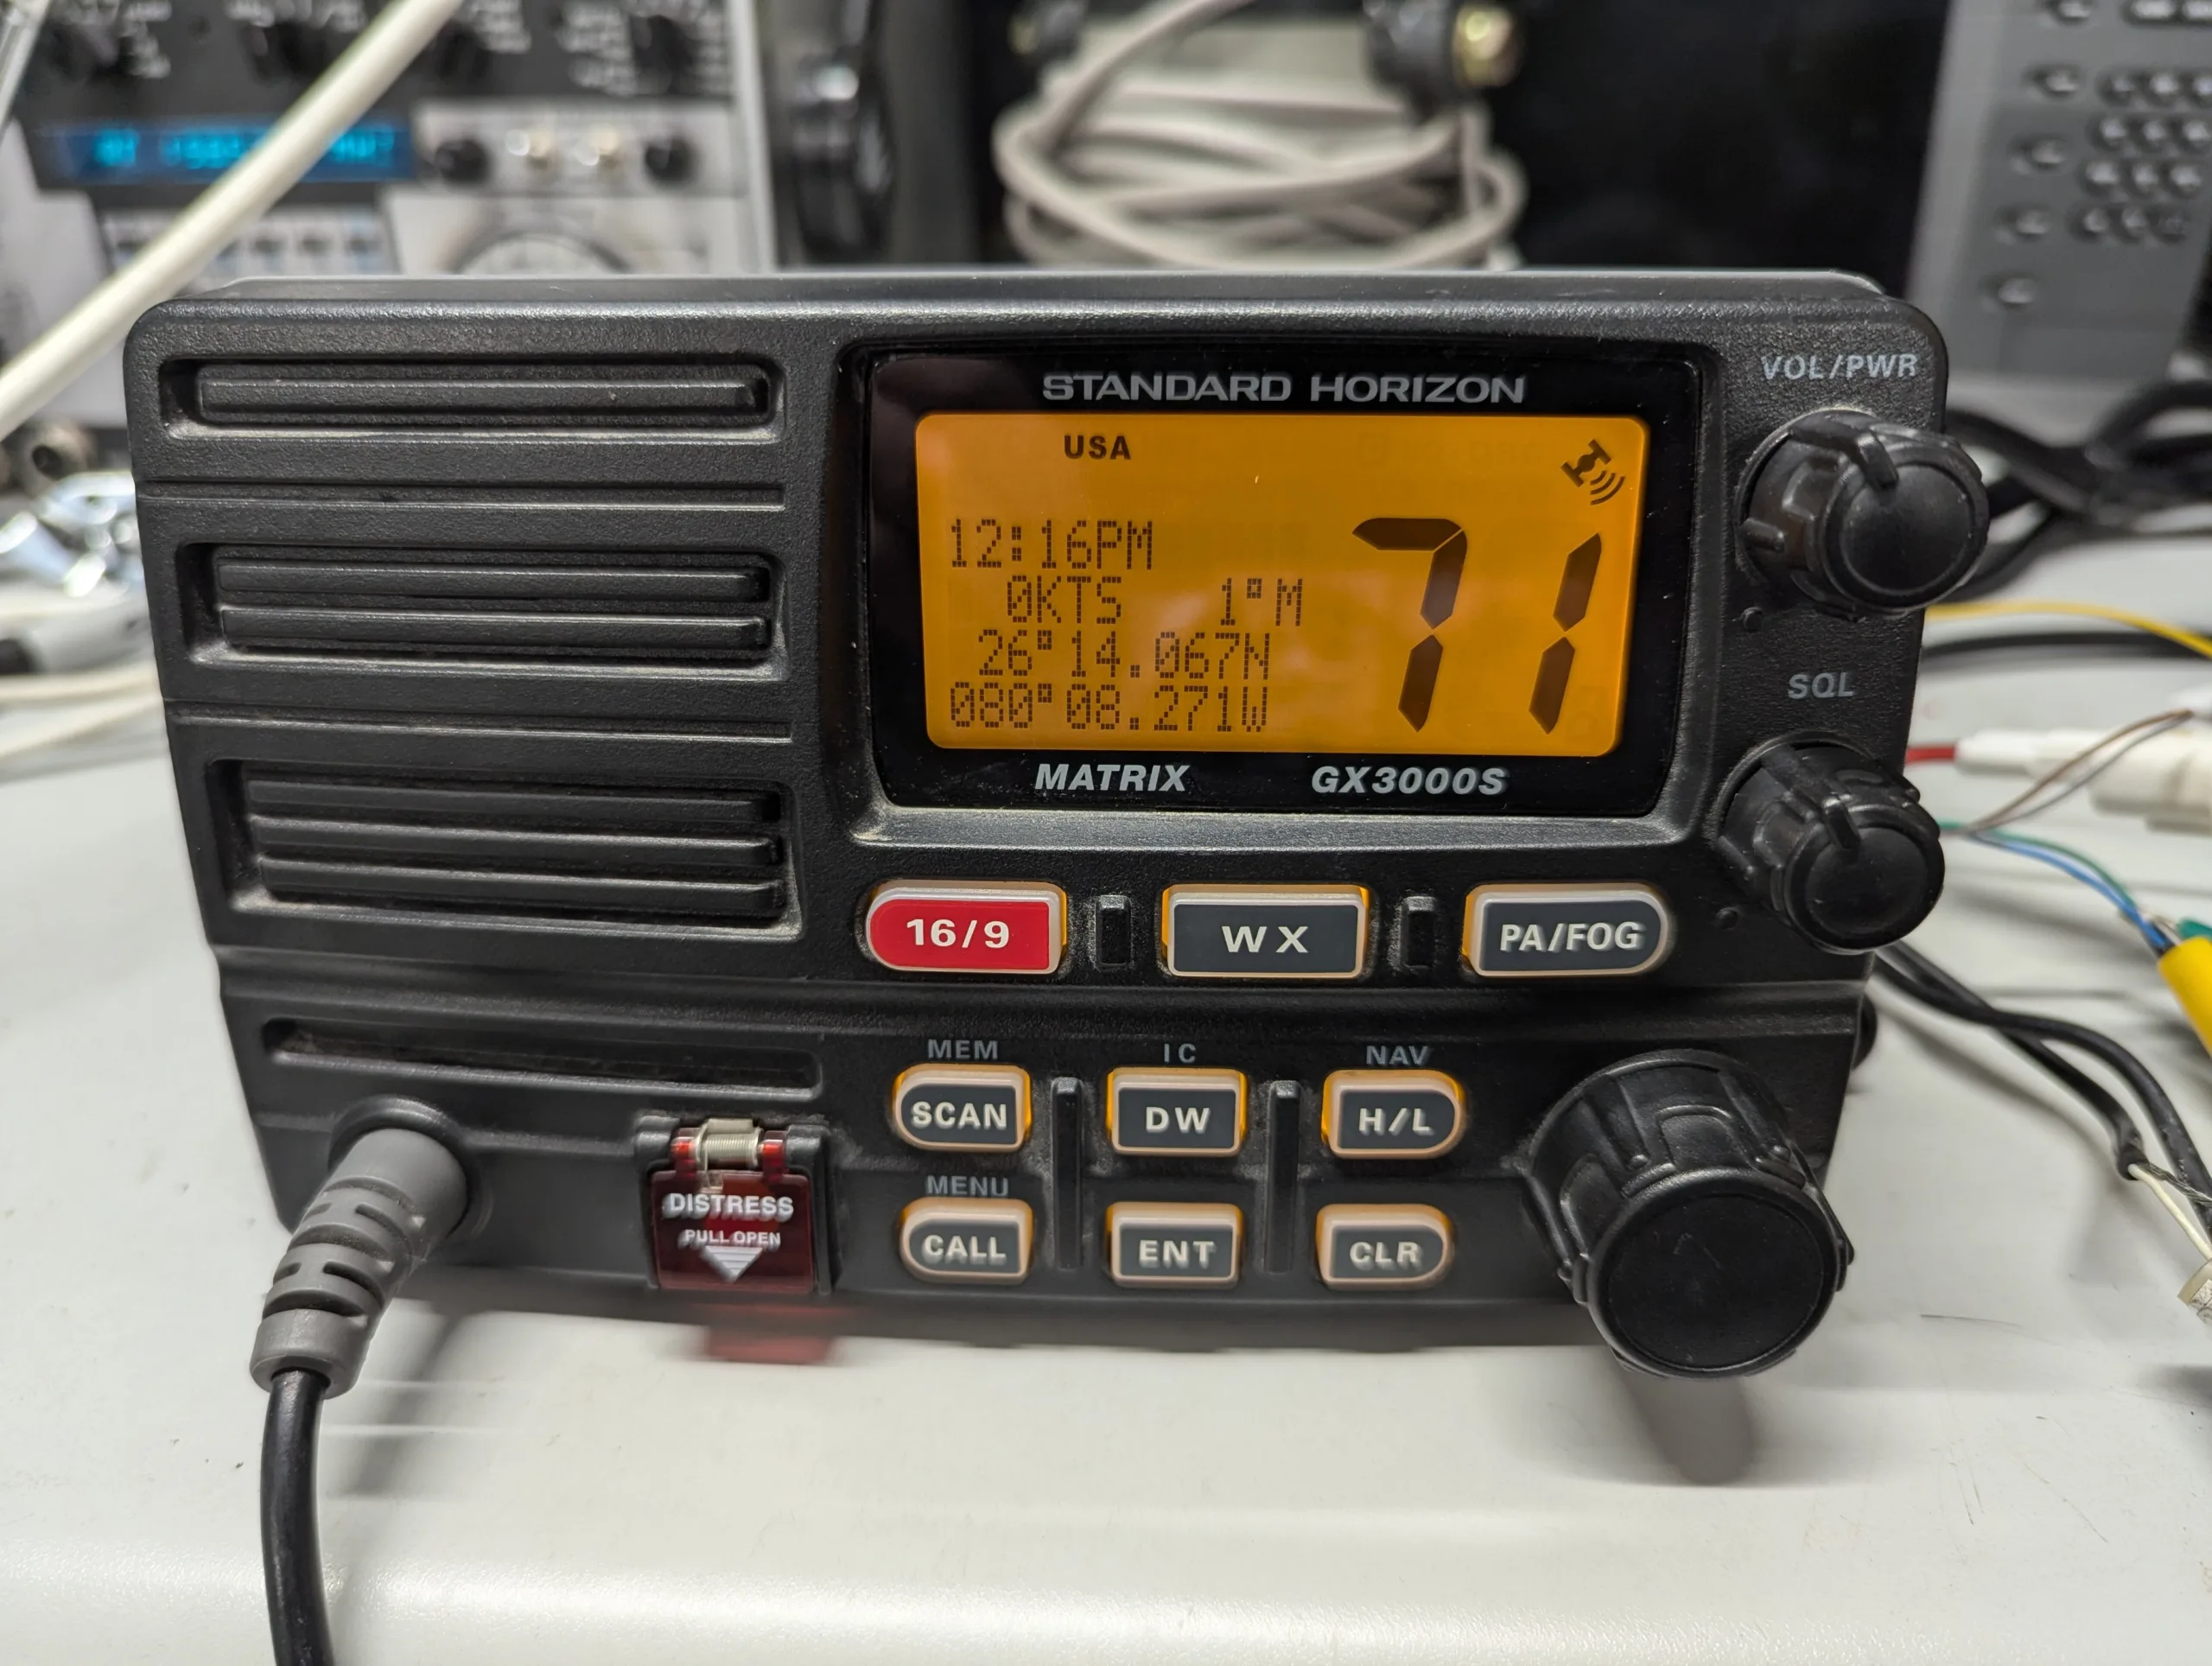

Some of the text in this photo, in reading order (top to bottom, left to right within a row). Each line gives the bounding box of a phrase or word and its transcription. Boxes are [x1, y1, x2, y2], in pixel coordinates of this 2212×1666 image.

[1762, 353, 1918, 383] VOL/PWR
[1042, 373, 1526, 405] STANDARD HORIZON
[1063, 434, 1132, 461] USA
[950, 518, 1153, 570] 12:16PM
[1007, 575, 1122, 624] 0KTS
[1351, 516, 1603, 734] 71
[1787, 671, 1855, 701] SQL
[1036, 763, 1509, 797] MATRIX GX3000S
[906, 918, 1011, 951] 16/9
[1498, 920, 1640, 952] PA/FOG
[927, 1040, 999, 1060] MEM
[1163, 1043, 1198, 1064] IC
[1364, 1045, 1429, 1066] NAV
[911, 1101, 1008, 1130] SCAN
[1145, 1105, 1211, 1133] DW
[1357, 1107, 1433, 1136] H/L
[925, 1175, 1009, 1199] MENU
[664, 1192, 794, 1221] DISTRESS
[680, 1229, 781, 1250] PULL OPEN
[921, 1233, 1007, 1263] CALL
[1137, 1239, 1216, 1268] ENT
[1349, 1240, 1421, 1268] CLR
